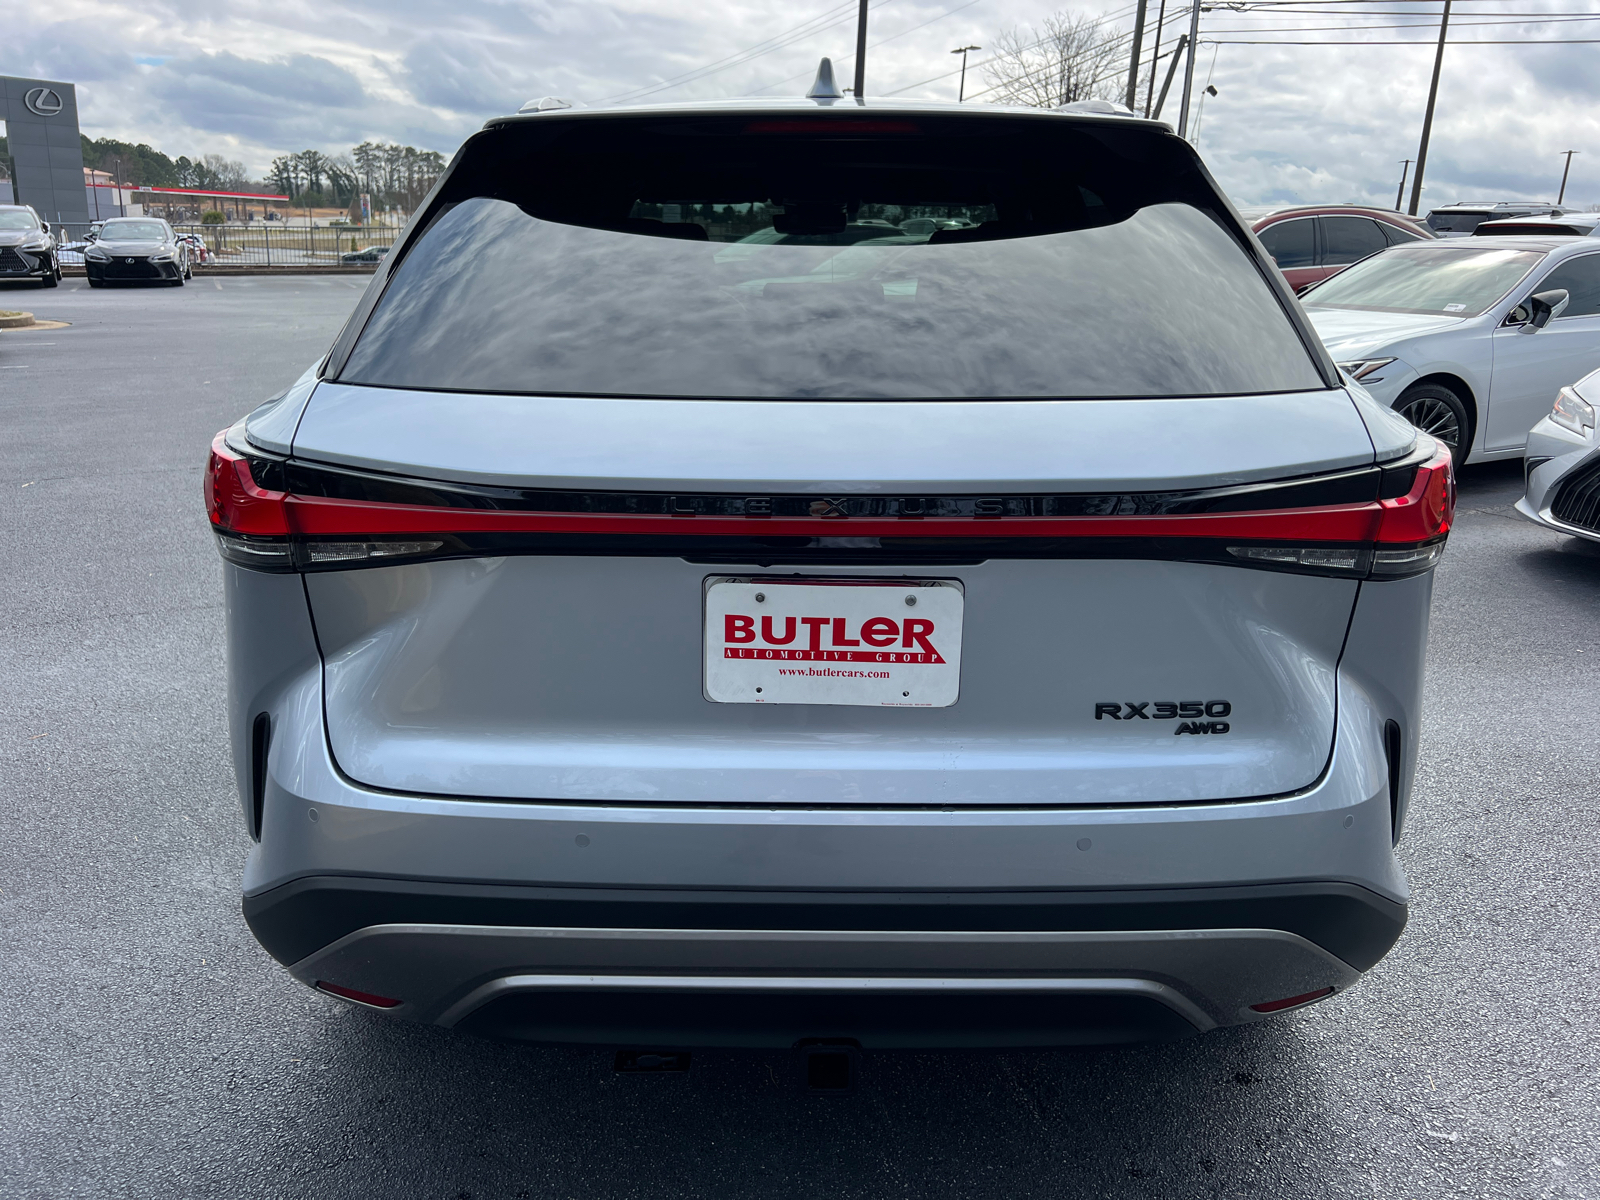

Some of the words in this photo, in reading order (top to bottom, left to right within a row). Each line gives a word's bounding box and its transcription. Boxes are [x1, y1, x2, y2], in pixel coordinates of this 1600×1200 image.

[670, 496, 1003, 516] LEXUS
[725, 648, 854, 661] AUTOMOTIVE
[875, 653, 938, 663] GROUP
[778, 667, 890, 679] www.butlercars.com
[1174, 721, 1231, 735] AWD
